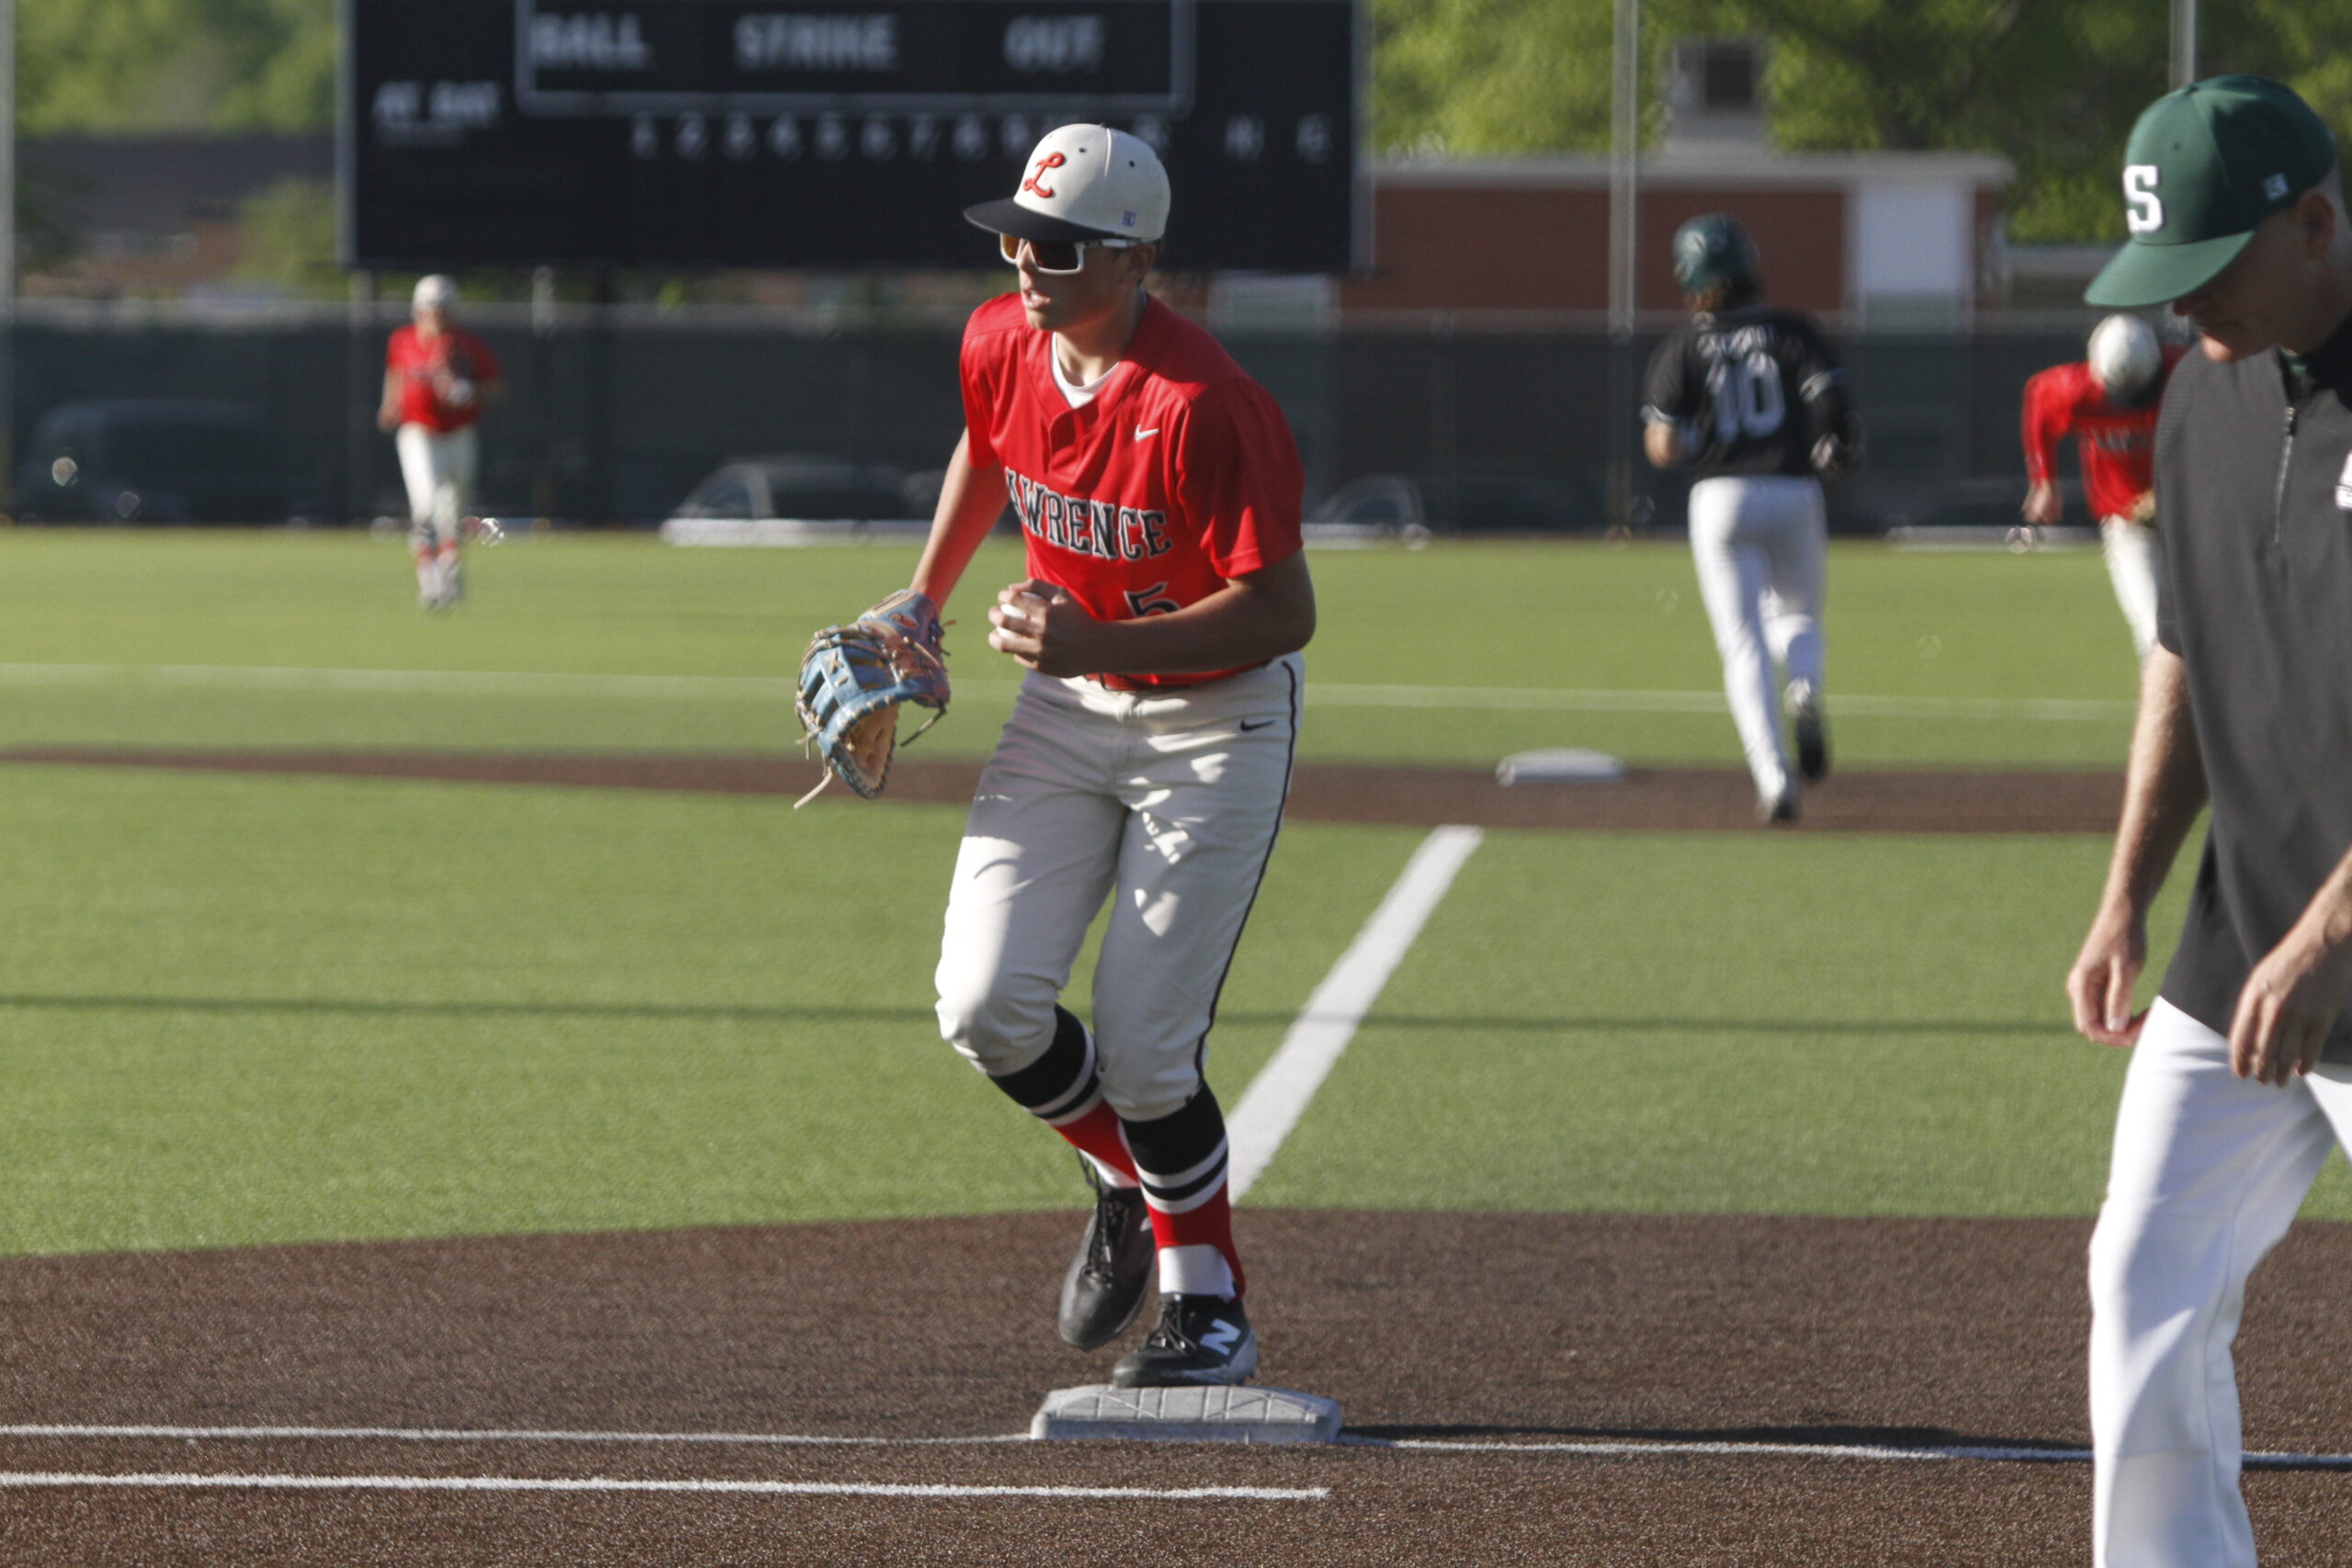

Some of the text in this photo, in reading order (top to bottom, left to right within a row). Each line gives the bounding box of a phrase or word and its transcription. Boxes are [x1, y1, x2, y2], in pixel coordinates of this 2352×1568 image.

[530, 13, 650, 70] BALL
[735, 14, 899, 70] STRIKE
[1003, 15, 1103, 71] OUT
[1023, 152, 1066, 198] L
[2123, 164, 2164, 232] S
[1706, 351, 1787, 444] 10
[1004, 466, 1172, 560] AWRENCE
